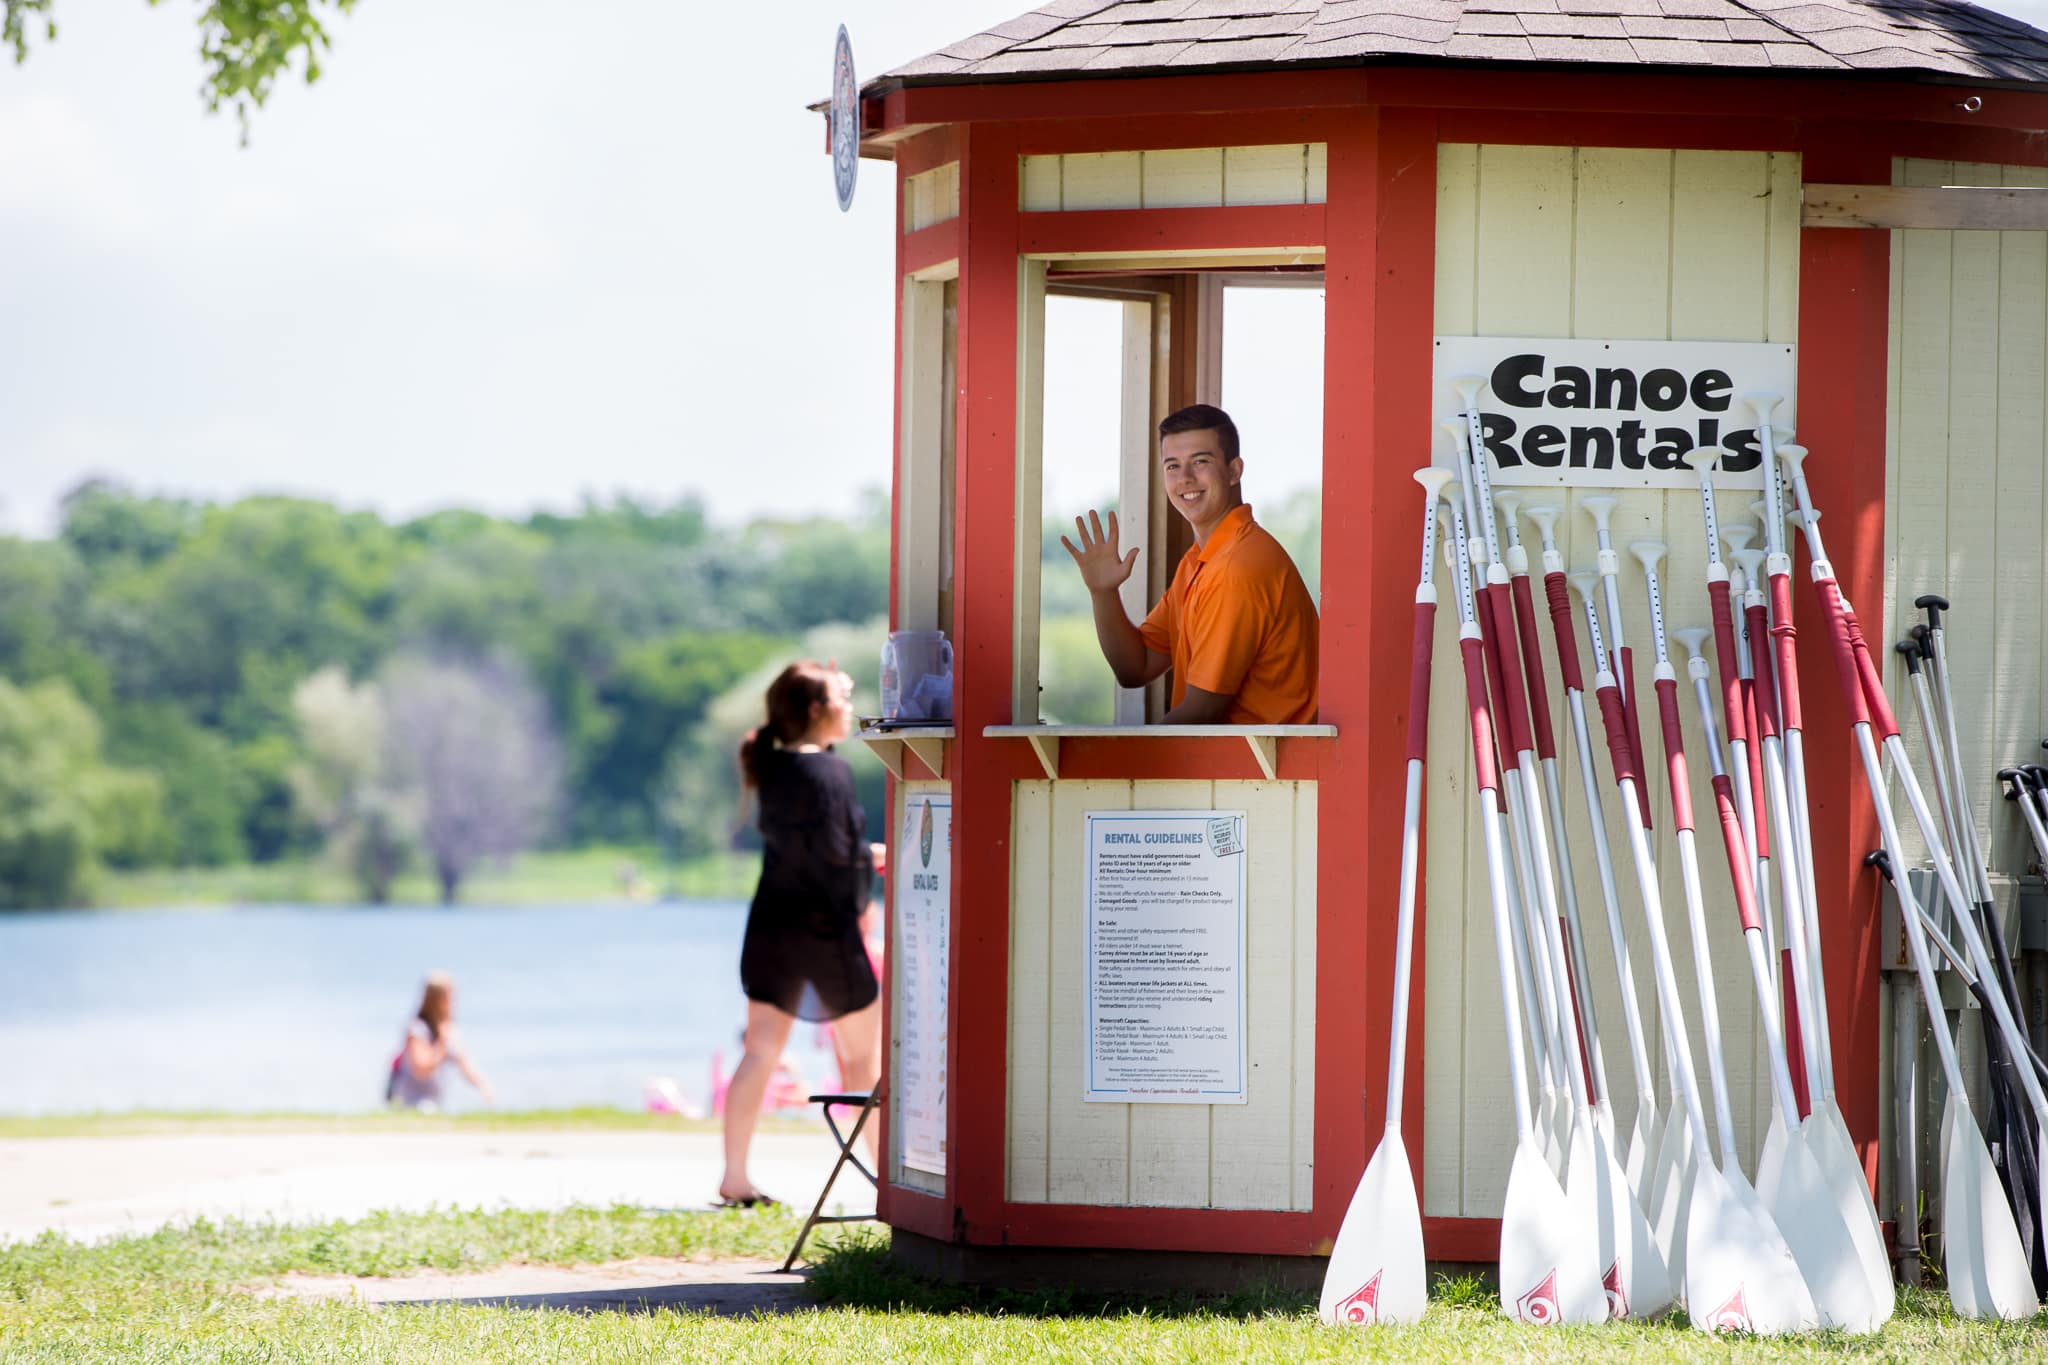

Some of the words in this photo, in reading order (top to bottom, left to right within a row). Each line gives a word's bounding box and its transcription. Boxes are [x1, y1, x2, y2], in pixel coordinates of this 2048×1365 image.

[1490, 353, 1734, 412] Canoe
[1457, 412, 1764, 473] Rentals
[1104, 833, 1141, 844] RENTAL
[1144, 833, 1203, 844] GUIDELINES
